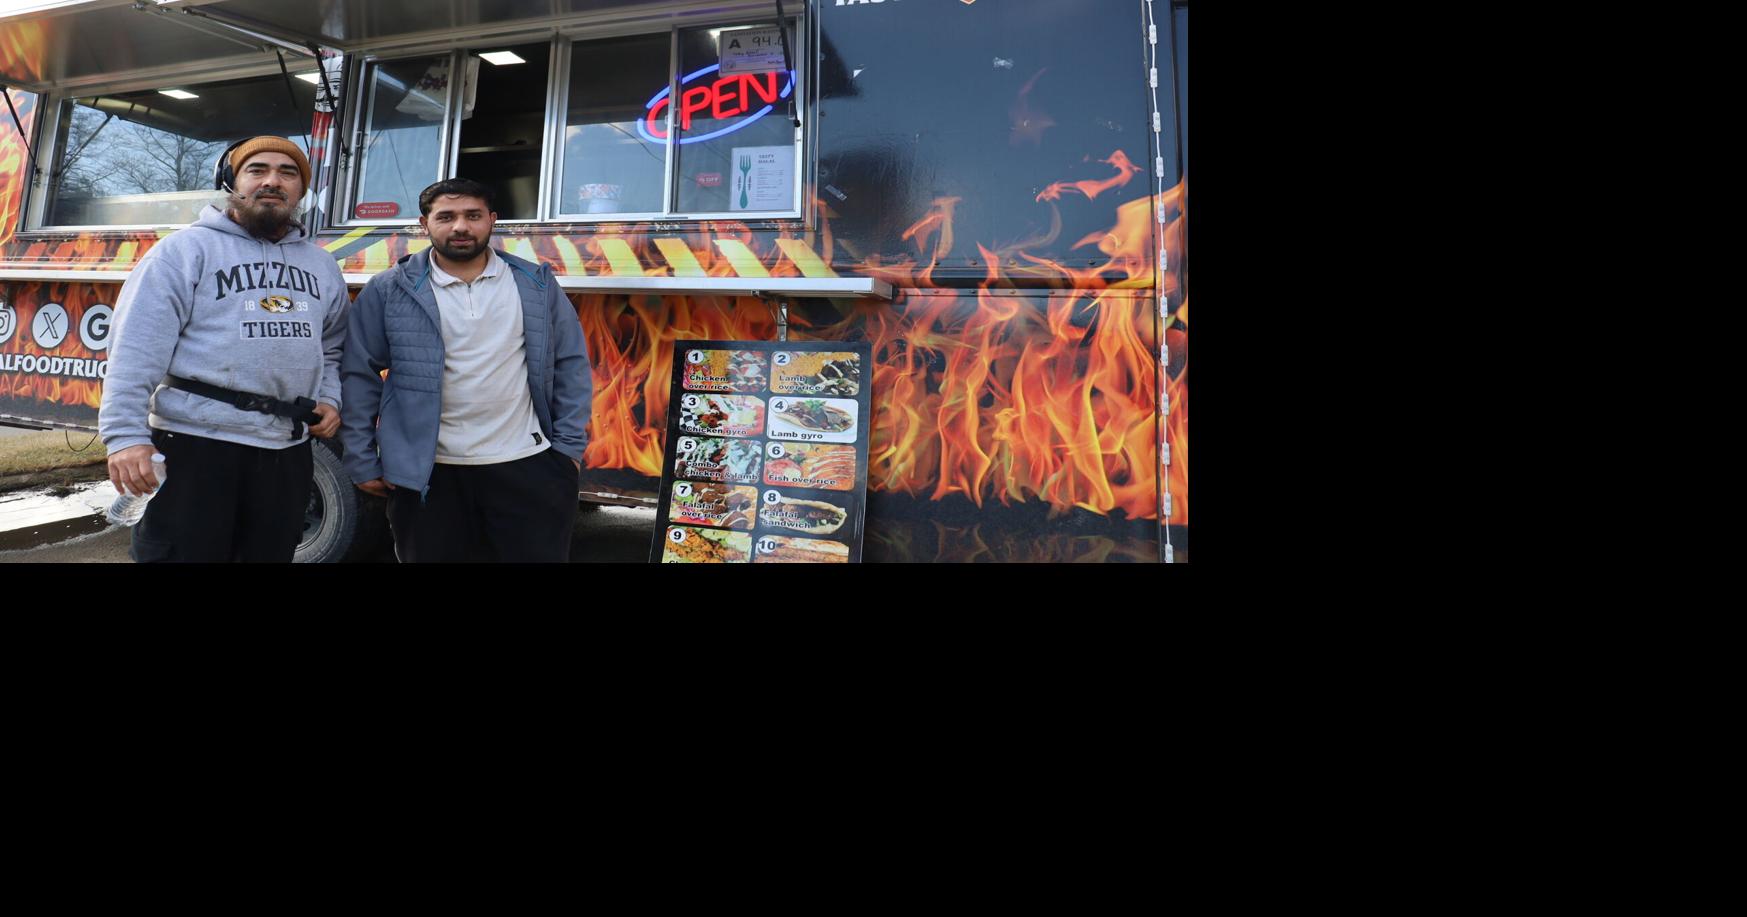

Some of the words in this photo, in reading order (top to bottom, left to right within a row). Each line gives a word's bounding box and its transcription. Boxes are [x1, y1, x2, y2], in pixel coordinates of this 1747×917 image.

[729, 39, 741, 49] A
[647, 70, 777, 138] OPEN
[215, 261, 321, 301] MIZZOU
[244, 300, 256, 311] 18
[295, 301, 309, 312] 39
[243, 321, 312, 338] TIGERS
[692, 352, 699, 361] 1
[777, 354, 787, 364] 2
[689, 374, 726, 382] Chicken
[688, 397, 697, 406] 3
[774, 401, 784, 410] 4
[686, 426, 723, 435] Chicken
[771, 430, 798, 438] Lamb
[801, 432, 823, 440] gyro
[684, 441, 693, 450] 5
[772, 446, 781, 455] 6
[686, 460, 718, 468] Combo
[684, 469, 721, 477] chicken
[734, 472, 759, 480] lamb
[768, 474, 789, 482] Fish
[680, 486, 688, 495] 7
[767, 492, 777, 502] 8
[762, 519, 811, 529] sandwich
[673, 530, 682, 540] 9
[758, 540, 776, 550] 10
